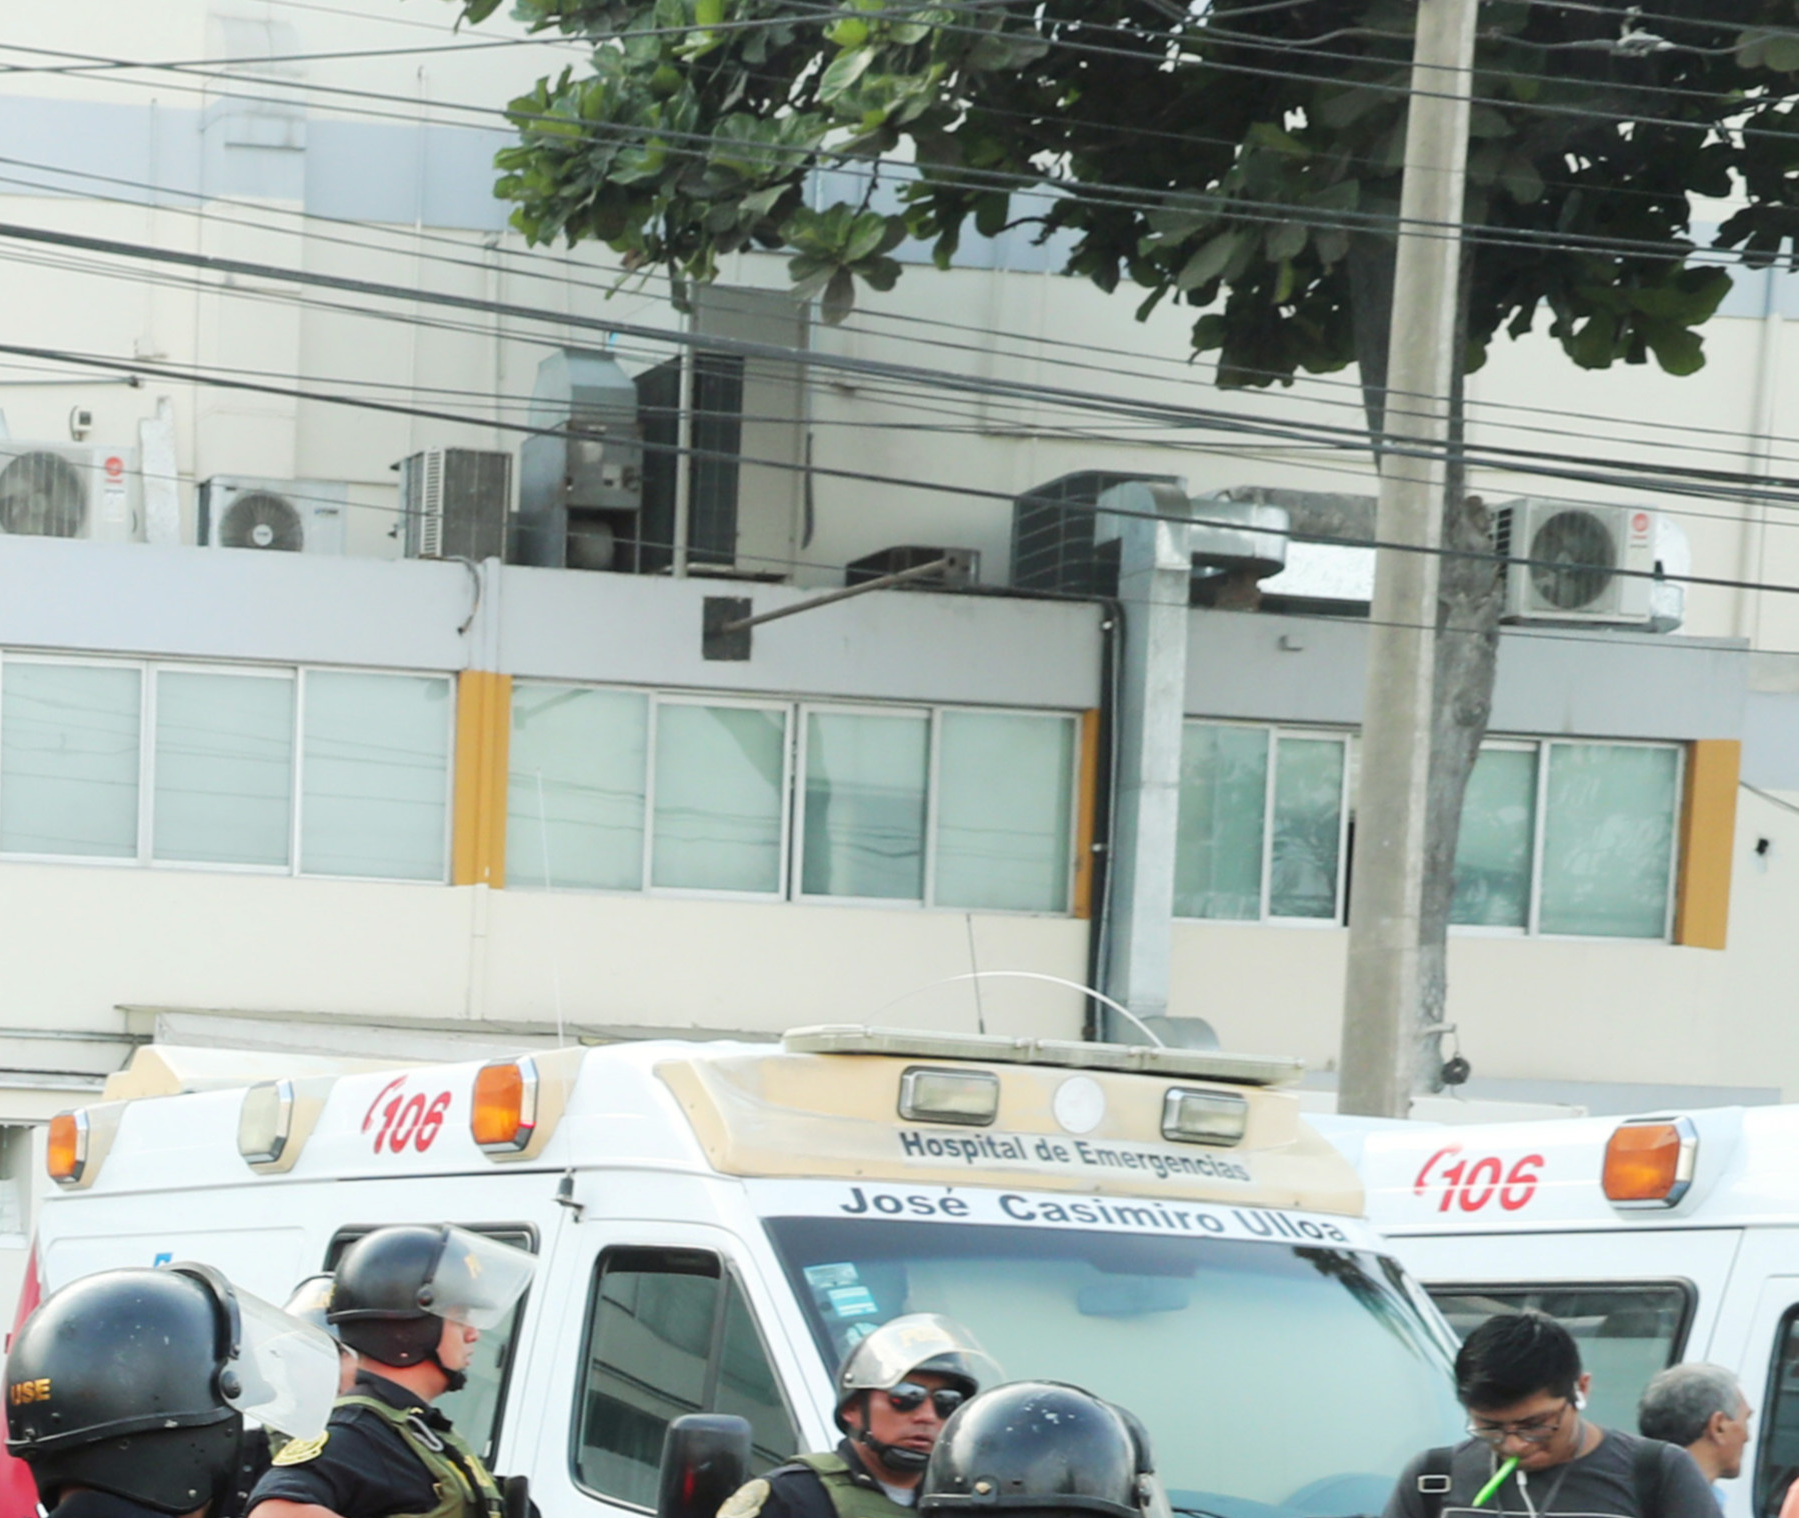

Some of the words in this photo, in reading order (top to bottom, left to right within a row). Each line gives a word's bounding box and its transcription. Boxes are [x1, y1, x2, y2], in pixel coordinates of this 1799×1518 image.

[373, 1089, 452, 1155] 106
[901, 1132, 1027, 1166] Hospital
[1034, 1138, 1069, 1162] de
[1079, 1141, 1252, 1182] Emergencias
[1438, 1153, 1545, 1213] 106
[840, 1187, 969, 1218] José
[1000, 1194, 1226, 1234] Casimiro
[1232, 1208, 1350, 1243] Ulloa
[9, 1378, 52, 1406] USE
